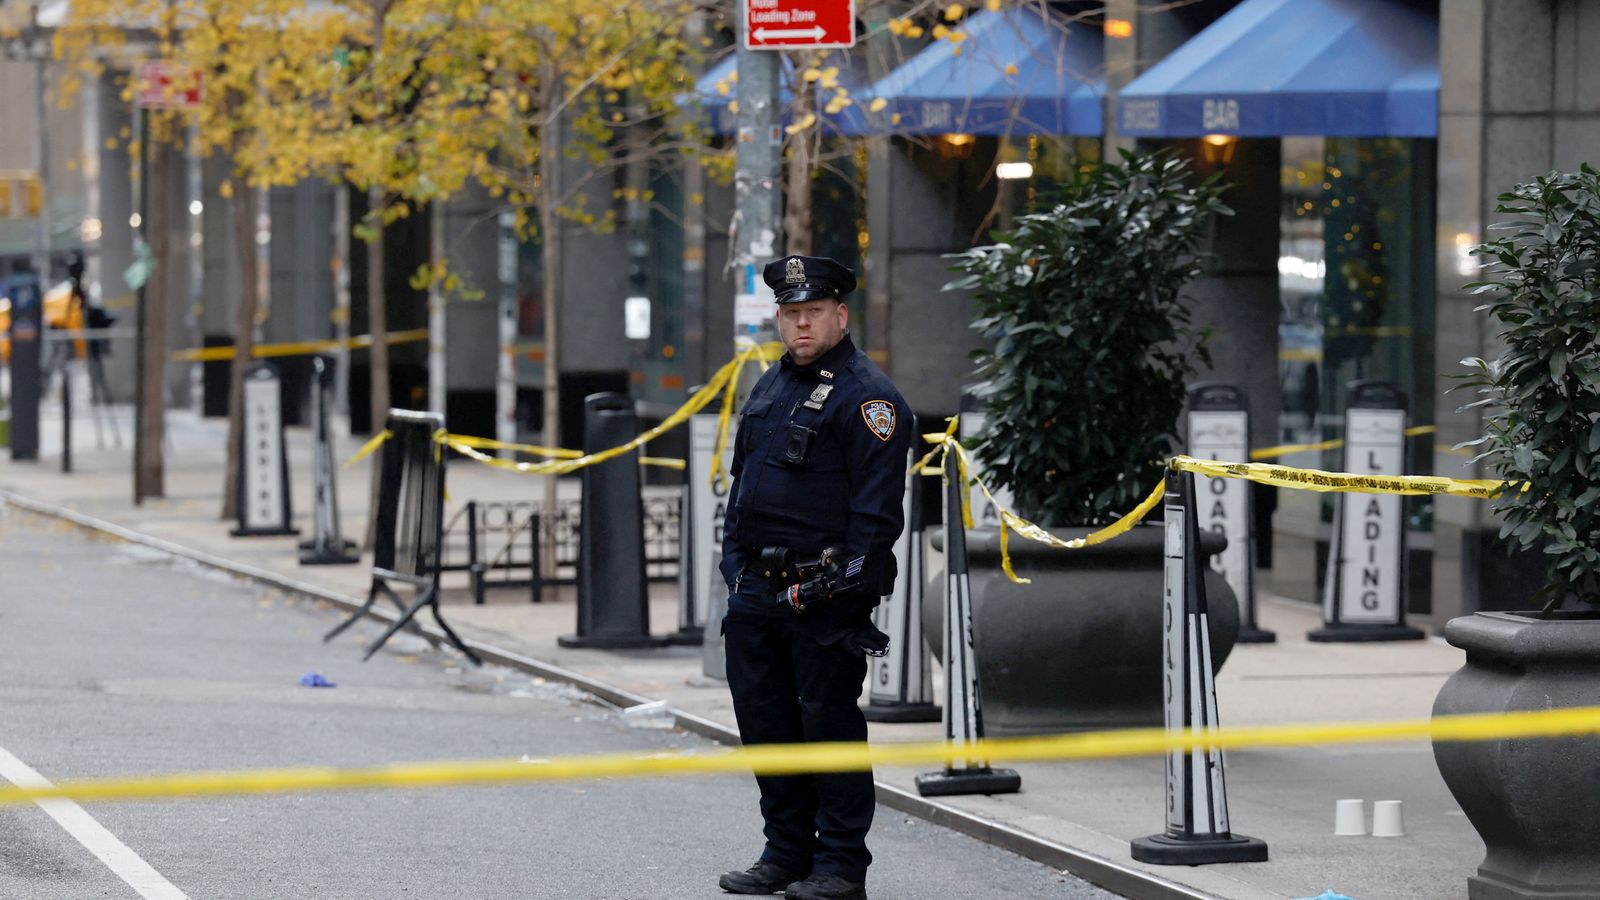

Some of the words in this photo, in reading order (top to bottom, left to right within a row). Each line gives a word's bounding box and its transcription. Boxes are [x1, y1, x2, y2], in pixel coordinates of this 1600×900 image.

[751, 9, 790, 24] Loading
[791, 9, 816, 22] Zone
[1203, 99, 1239, 130] BAR
[1361, 450, 1382, 612] LADING
